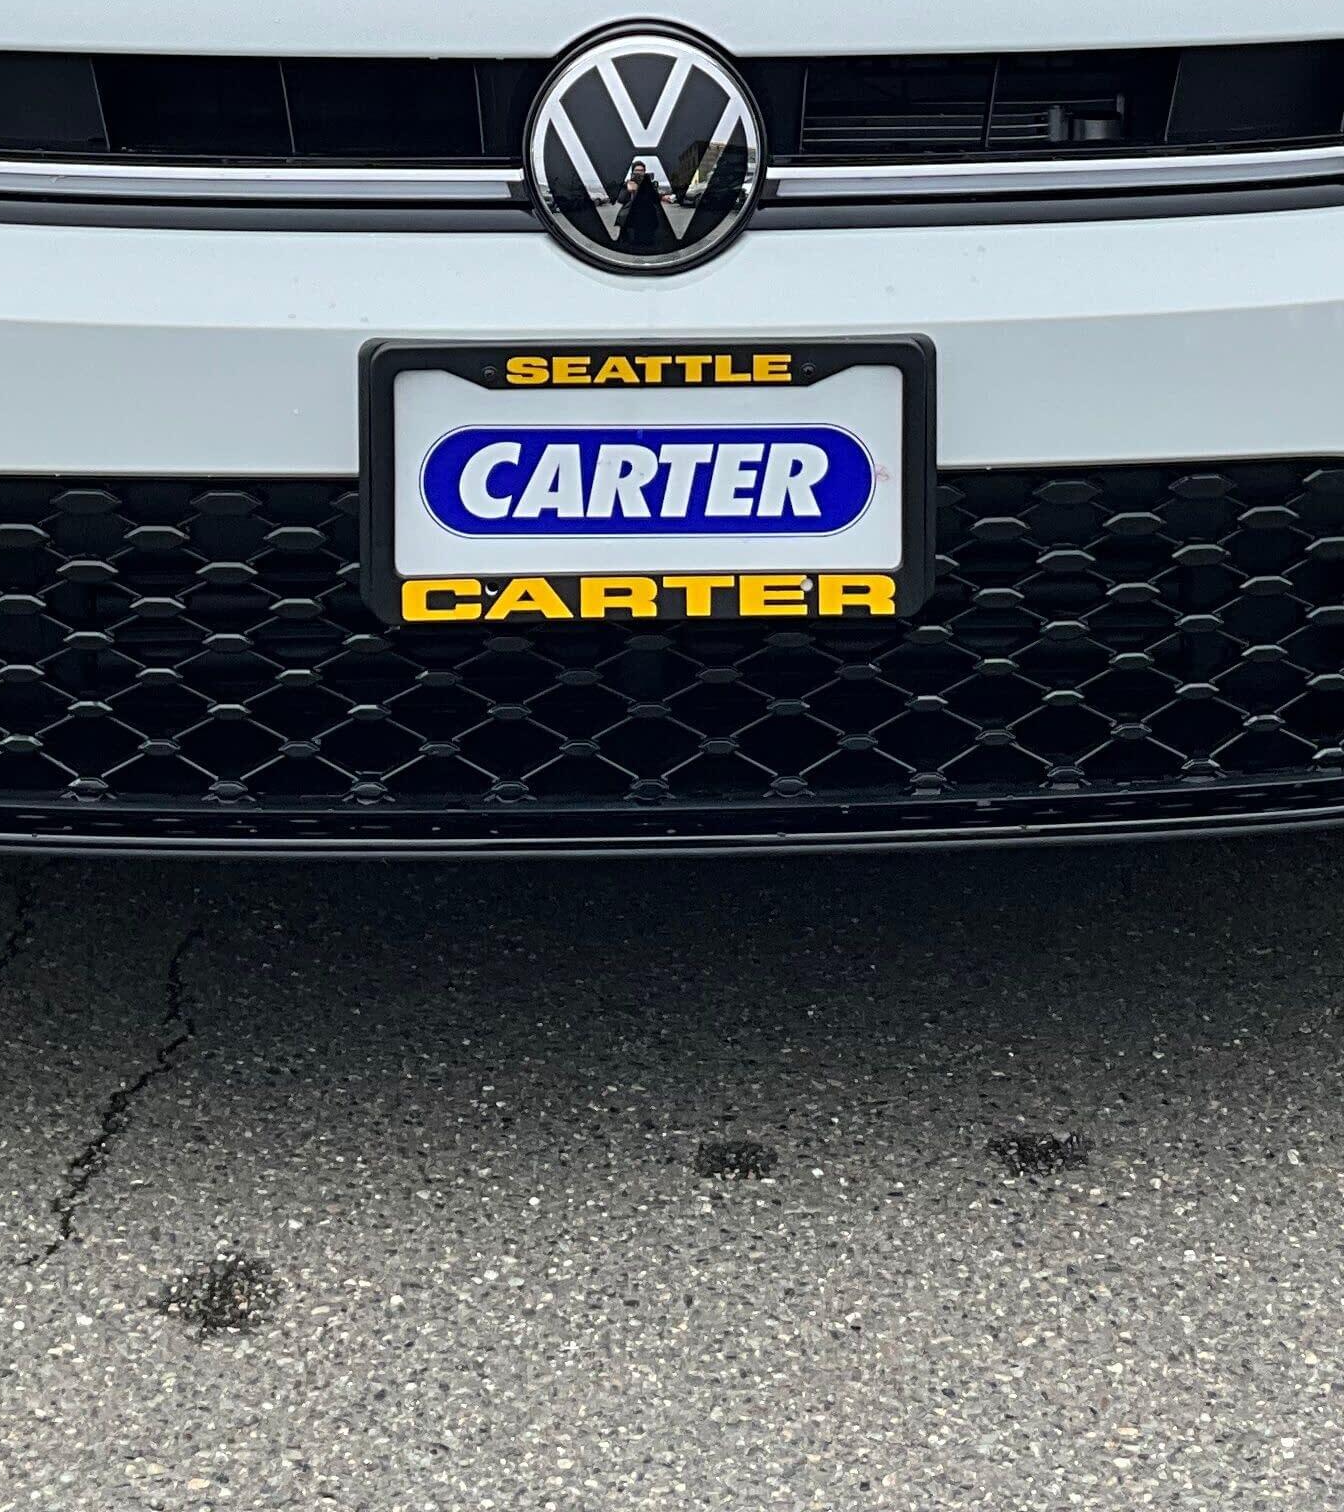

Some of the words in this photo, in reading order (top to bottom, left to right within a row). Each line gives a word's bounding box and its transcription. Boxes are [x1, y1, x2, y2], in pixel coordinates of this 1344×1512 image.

[506, 355, 792, 384] SEATTLE
[459, 442, 829, 519] CARTER
[401, 575, 896, 622] CARTER
